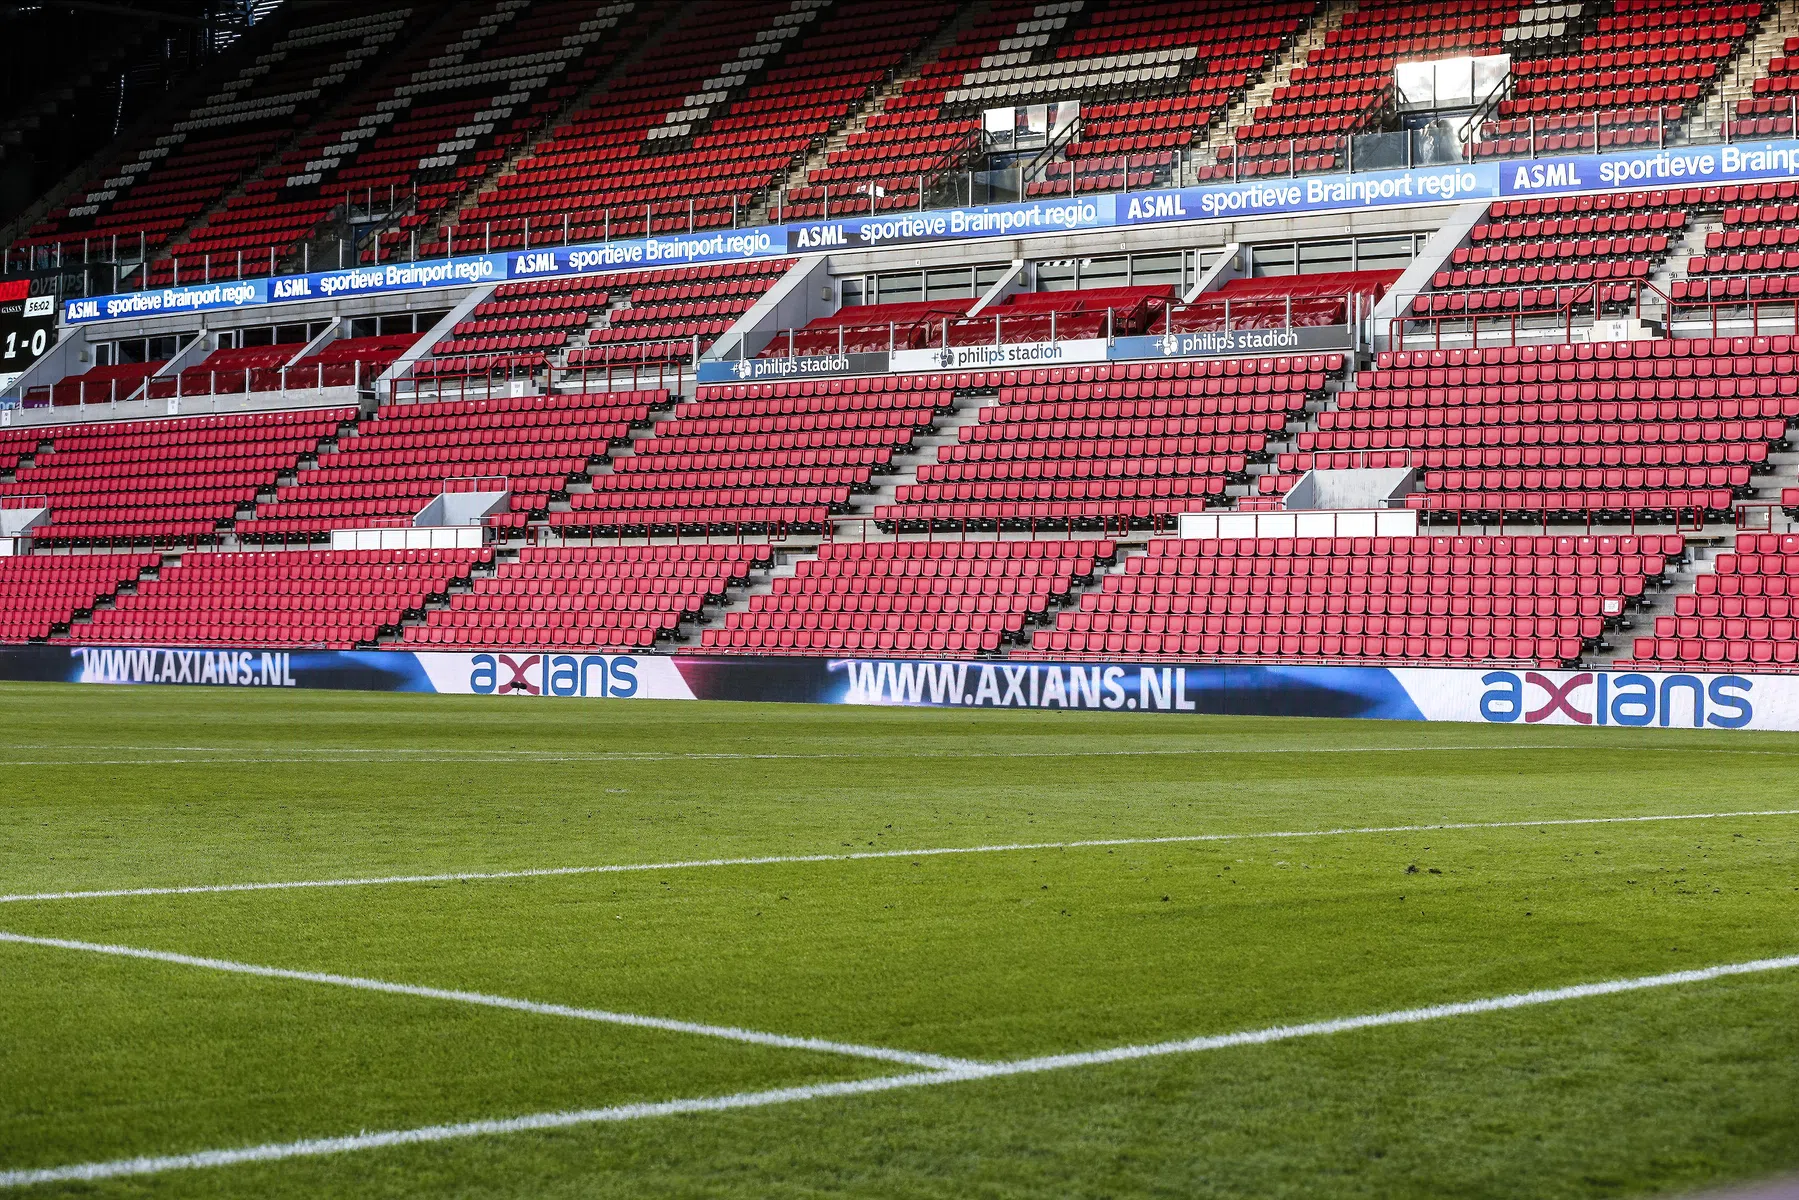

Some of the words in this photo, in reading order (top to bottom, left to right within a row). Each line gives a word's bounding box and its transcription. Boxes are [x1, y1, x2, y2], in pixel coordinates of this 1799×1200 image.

[1513, 162, 1582, 190] ASML
[1599, 151, 1715, 187] sportieve
[1127, 194, 1186, 220] ASML
[1200, 183, 1301, 215] sportieve
[1307, 172, 1413, 204] Brainport
[1416, 168, 1476, 199] regio
[796, 224, 848, 248] ASML
[860, 215, 946, 245] sportieve
[950, 206, 1041, 235] Brainport
[1045, 199, 1096, 228] regio
[515, 252, 559, 274] ASML
[569, 243, 643, 271] sportieve
[646, 233, 722, 262] Brainport
[727, 229, 771, 256] regio
[274, 278, 312, 298] ASML
[320, 269, 385, 295] sportieve
[386, 262, 453, 288] Brainport
[454, 257, 493, 281] regio
[29, 301, 50, 312] 56:02
[67, 300, 101, 322] ASML
[107, 292, 162, 317] sportieve
[163, 284, 221, 311] Brainport
[222, 282, 256, 305] regio
[958, 347, 1005, 367] philips
[1009, 343, 1062, 361] stadion
[1183, 333, 1234, 355] philips
[1238, 329, 1298, 349] stadion
[754, 357, 797, 377] philips
[801, 354, 849, 373] stadion
[82, 649, 296, 687] WWW.AXIANS.NL
[470, 653, 639, 697] axians
[847, 661, 1196, 710] WWW.AXIANS.NL
[1479, 671, 1754, 729] axians
